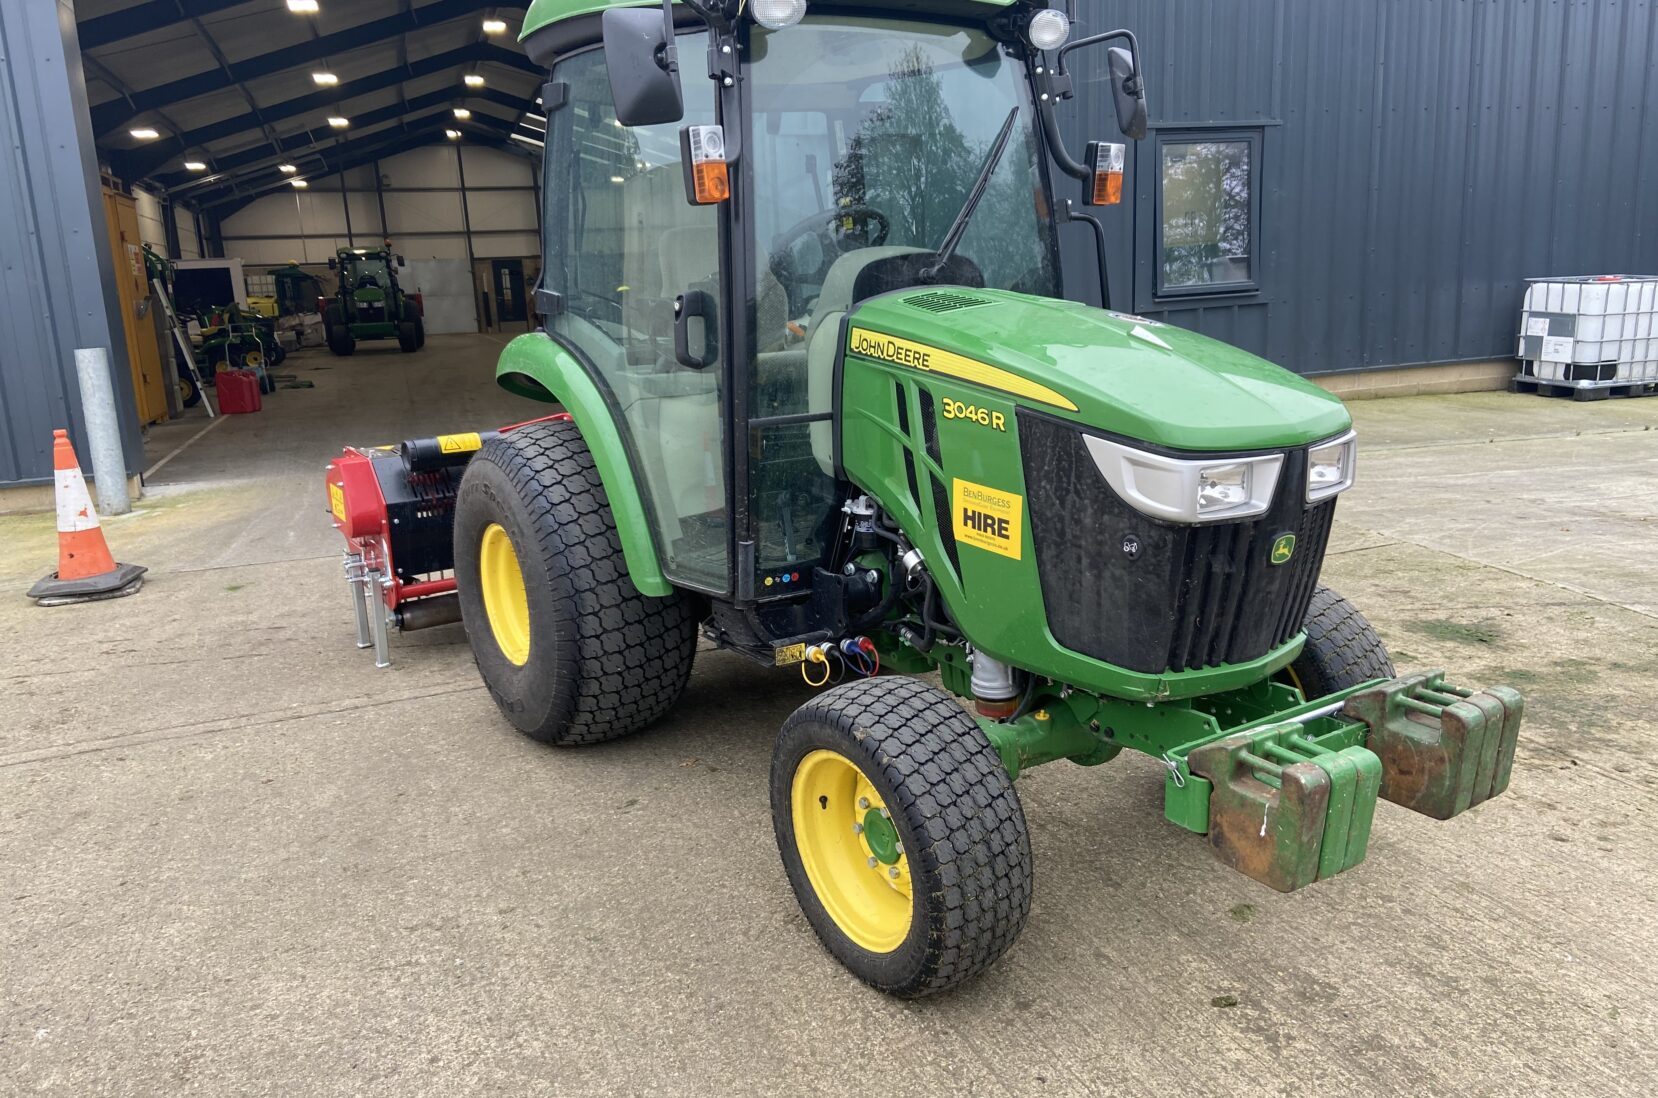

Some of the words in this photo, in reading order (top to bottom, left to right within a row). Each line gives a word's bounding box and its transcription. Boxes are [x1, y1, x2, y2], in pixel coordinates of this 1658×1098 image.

[854, 334, 885, 357] JOHN
[886, 340, 931, 368] DEERE
[942, 397, 990, 426] 3046
[991, 410, 1006, 432] R
[963, 507, 1010, 540] HIRE
